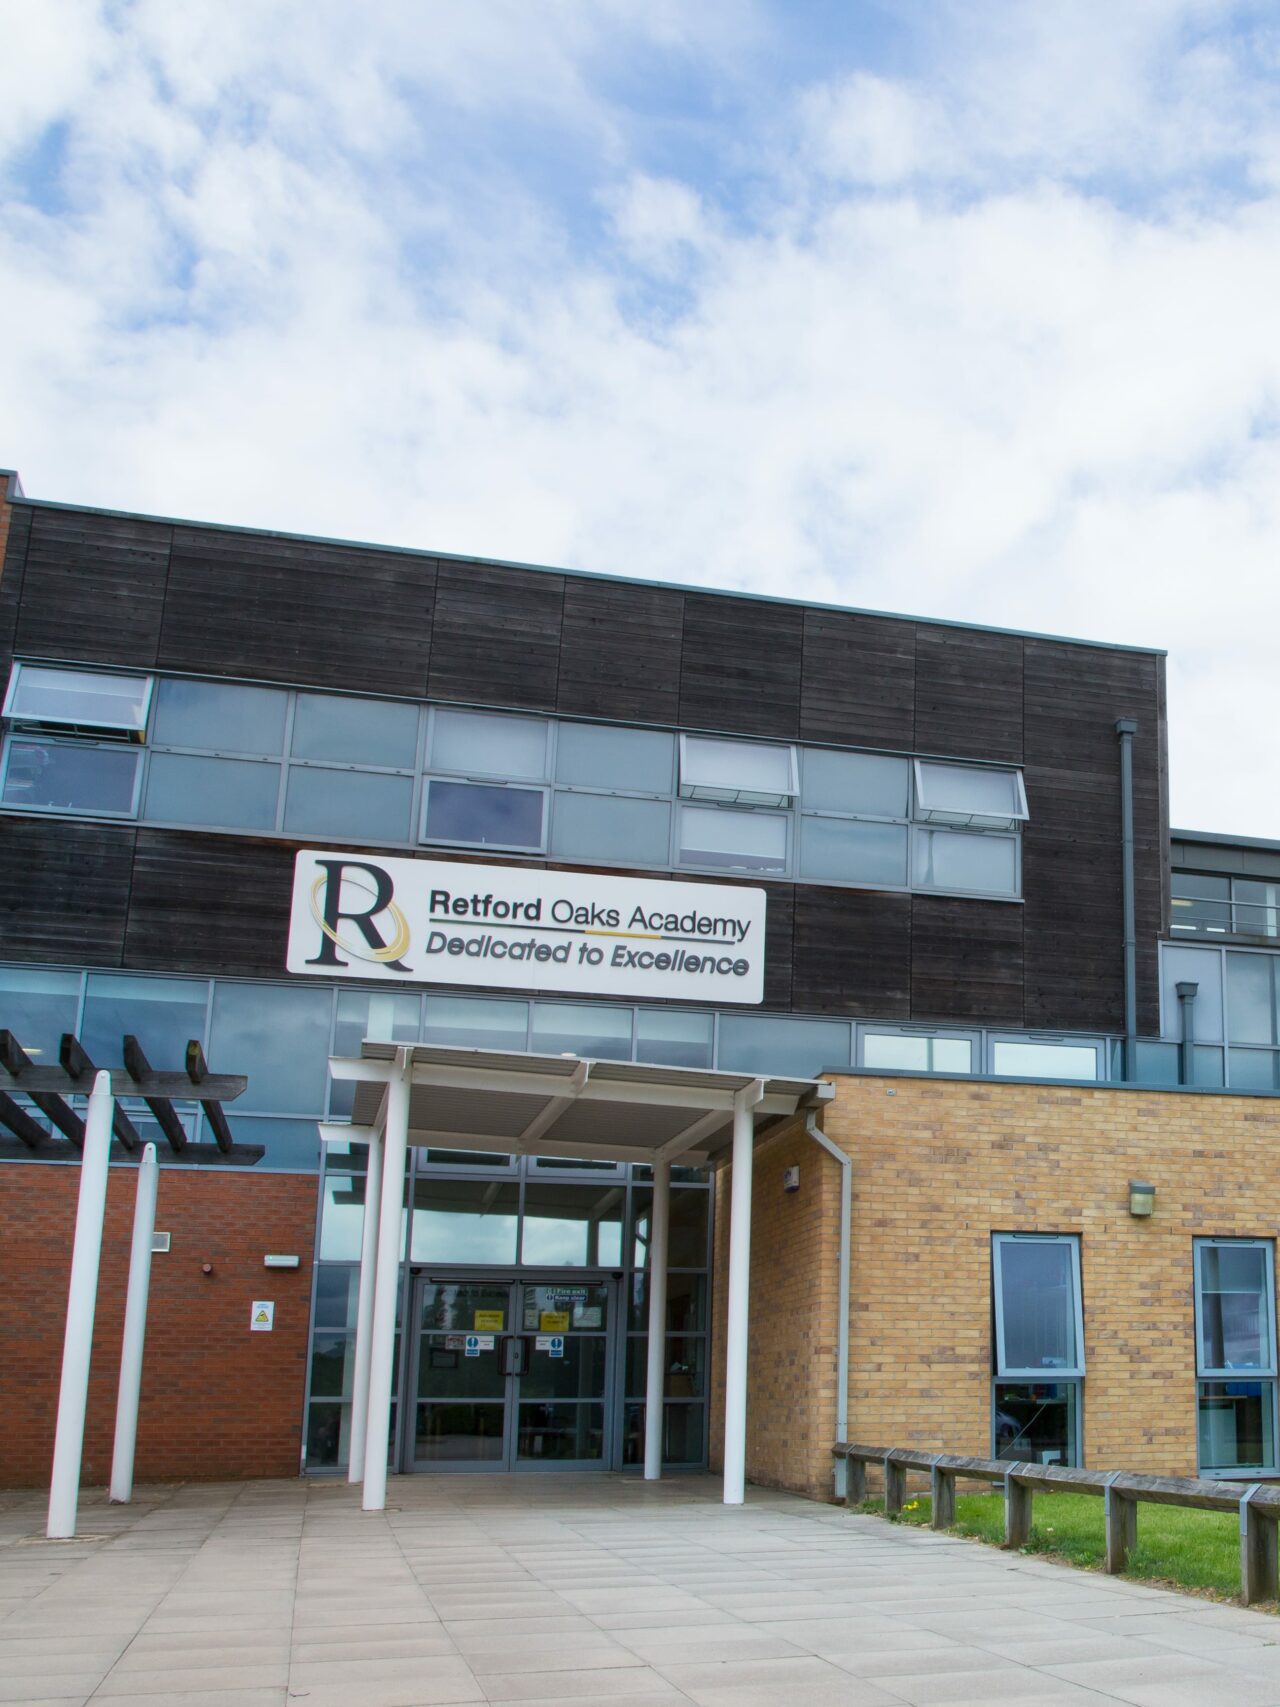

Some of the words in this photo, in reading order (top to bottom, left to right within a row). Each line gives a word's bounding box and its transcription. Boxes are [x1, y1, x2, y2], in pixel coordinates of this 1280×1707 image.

[304, 859, 414, 972] R
[429, 889, 542, 921] Retford
[551, 900, 620, 927] Oaks
[628, 905, 752, 942] Academy
[426, 931, 572, 963] Dedicated
[579, 941, 604, 965] to
[610, 945, 750, 977] Excellence
